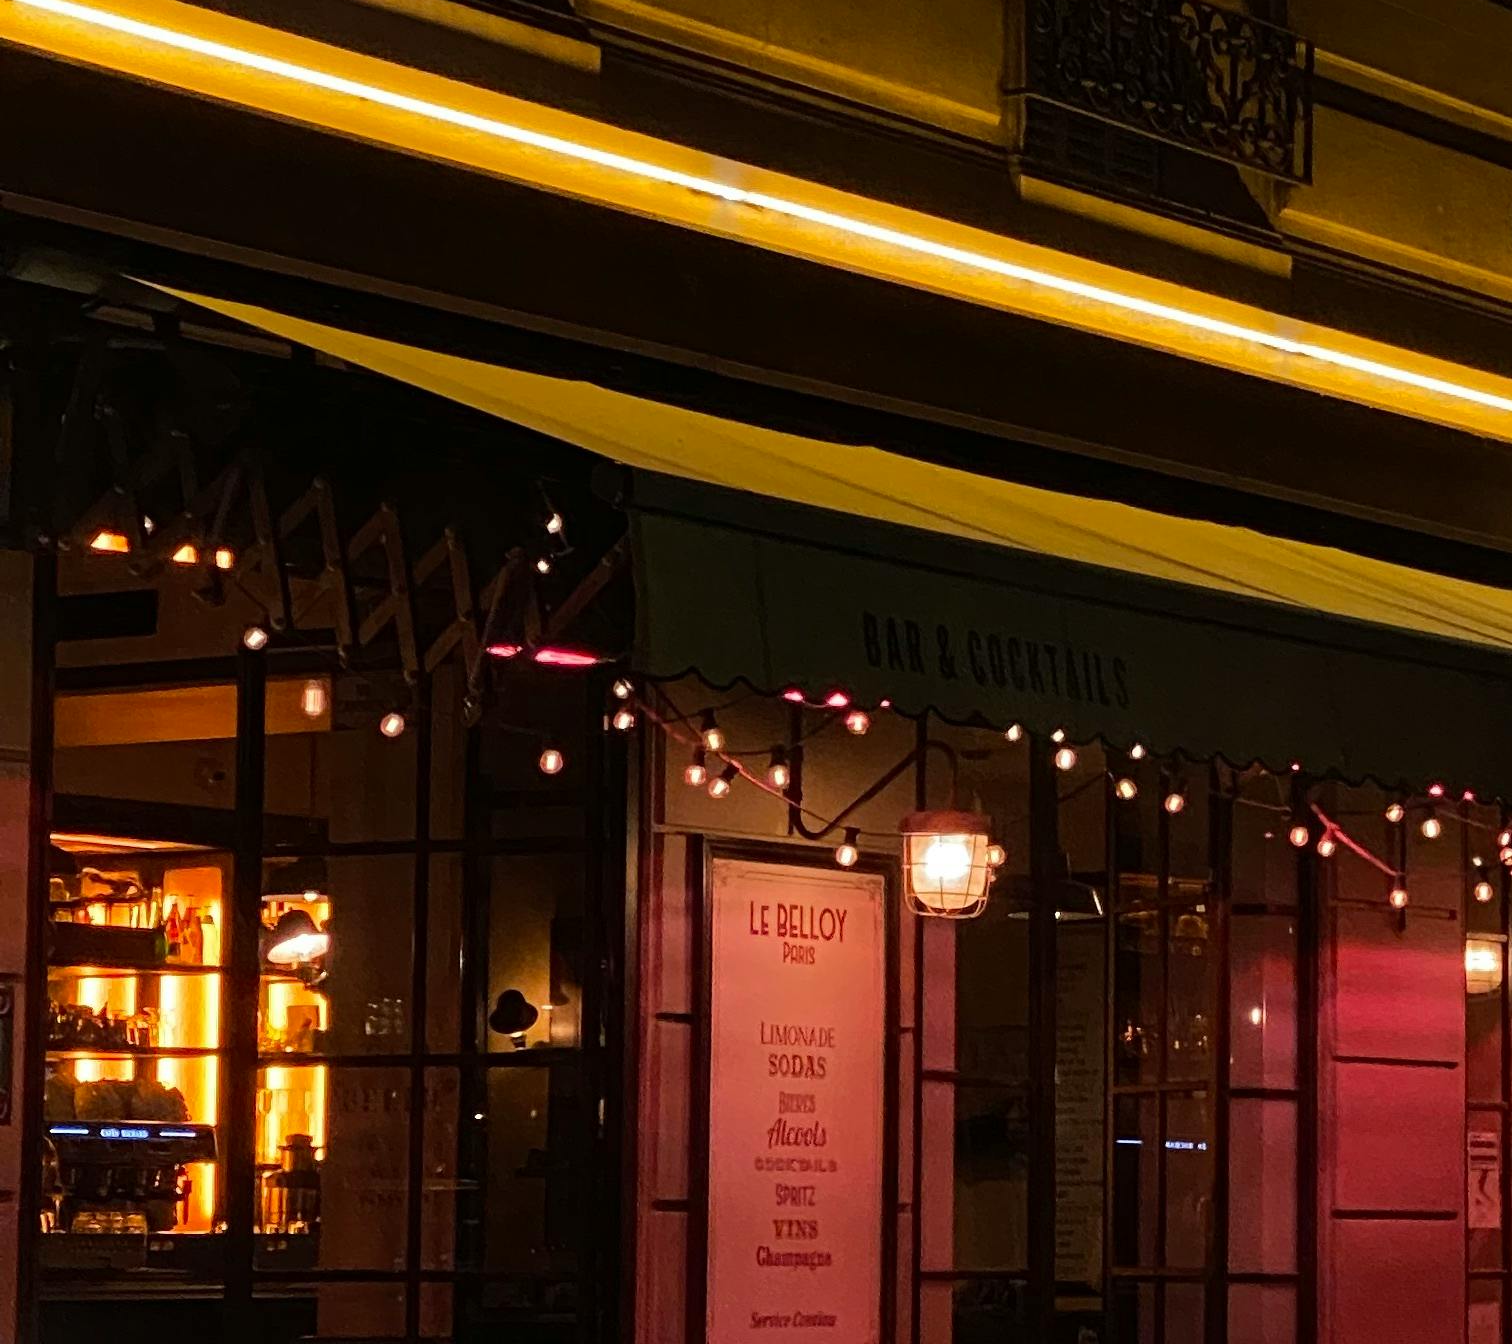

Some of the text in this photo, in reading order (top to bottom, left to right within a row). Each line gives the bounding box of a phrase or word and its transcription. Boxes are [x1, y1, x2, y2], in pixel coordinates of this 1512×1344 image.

[862, 610, 1131, 710] BAR & COCKTAILS
[750, 901, 848, 943] LE BELLOY
[760, 1021, 835, 1048] LIMONADE
[768, 1054, 827, 1079] SODAS
[767, 1117, 827, 1149] Alcools
[775, 1183, 816, 1207] SPRITZ
[773, 1219, 818, 1240] VINS
